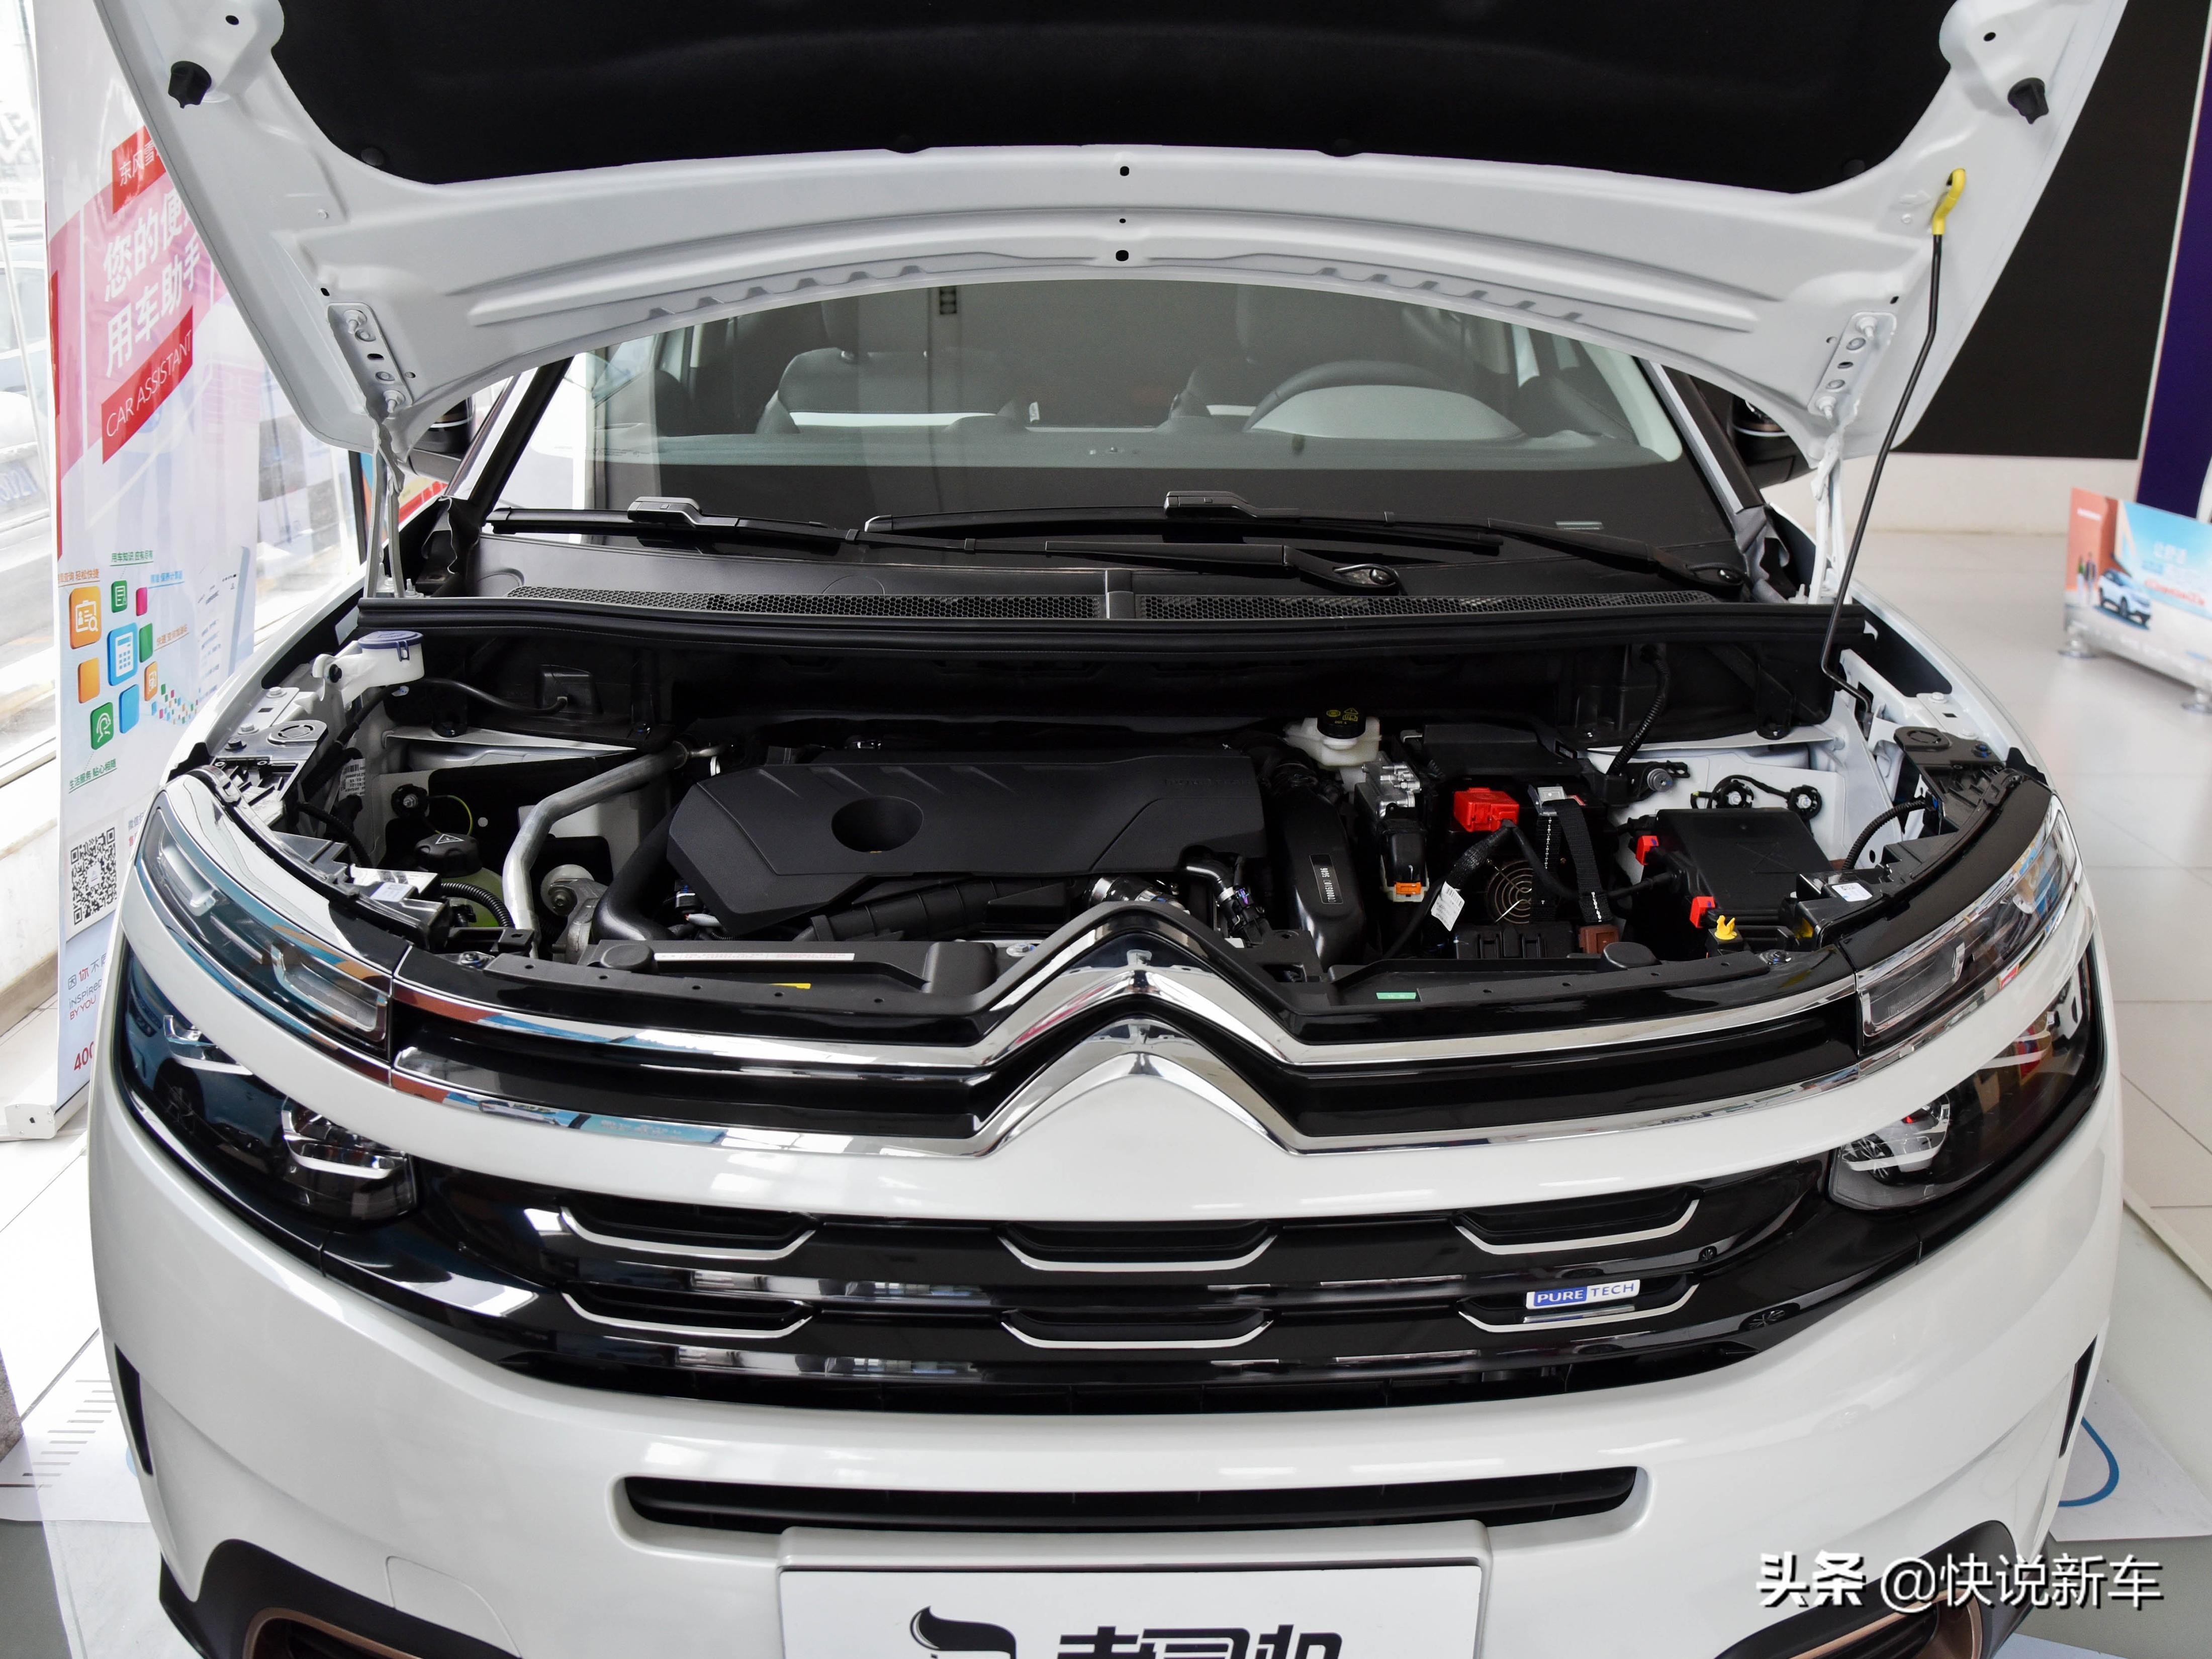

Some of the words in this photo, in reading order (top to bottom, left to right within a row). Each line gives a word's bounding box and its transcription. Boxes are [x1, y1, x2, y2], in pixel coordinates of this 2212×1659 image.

[120, 140, 155, 186] 东风雪
[103, 189, 190, 302] 您的便
[106, 231, 201, 378] 用车助手
[106, 398, 134, 436] CAR
[137, 329, 192, 411] ASSISTANT
[70, 1004, 79, 1021] BY
[80, 994, 97, 1012] YOU
[1537, 1289, 1583, 1304] PURE
[1591, 1282, 1634, 1298] TECH
